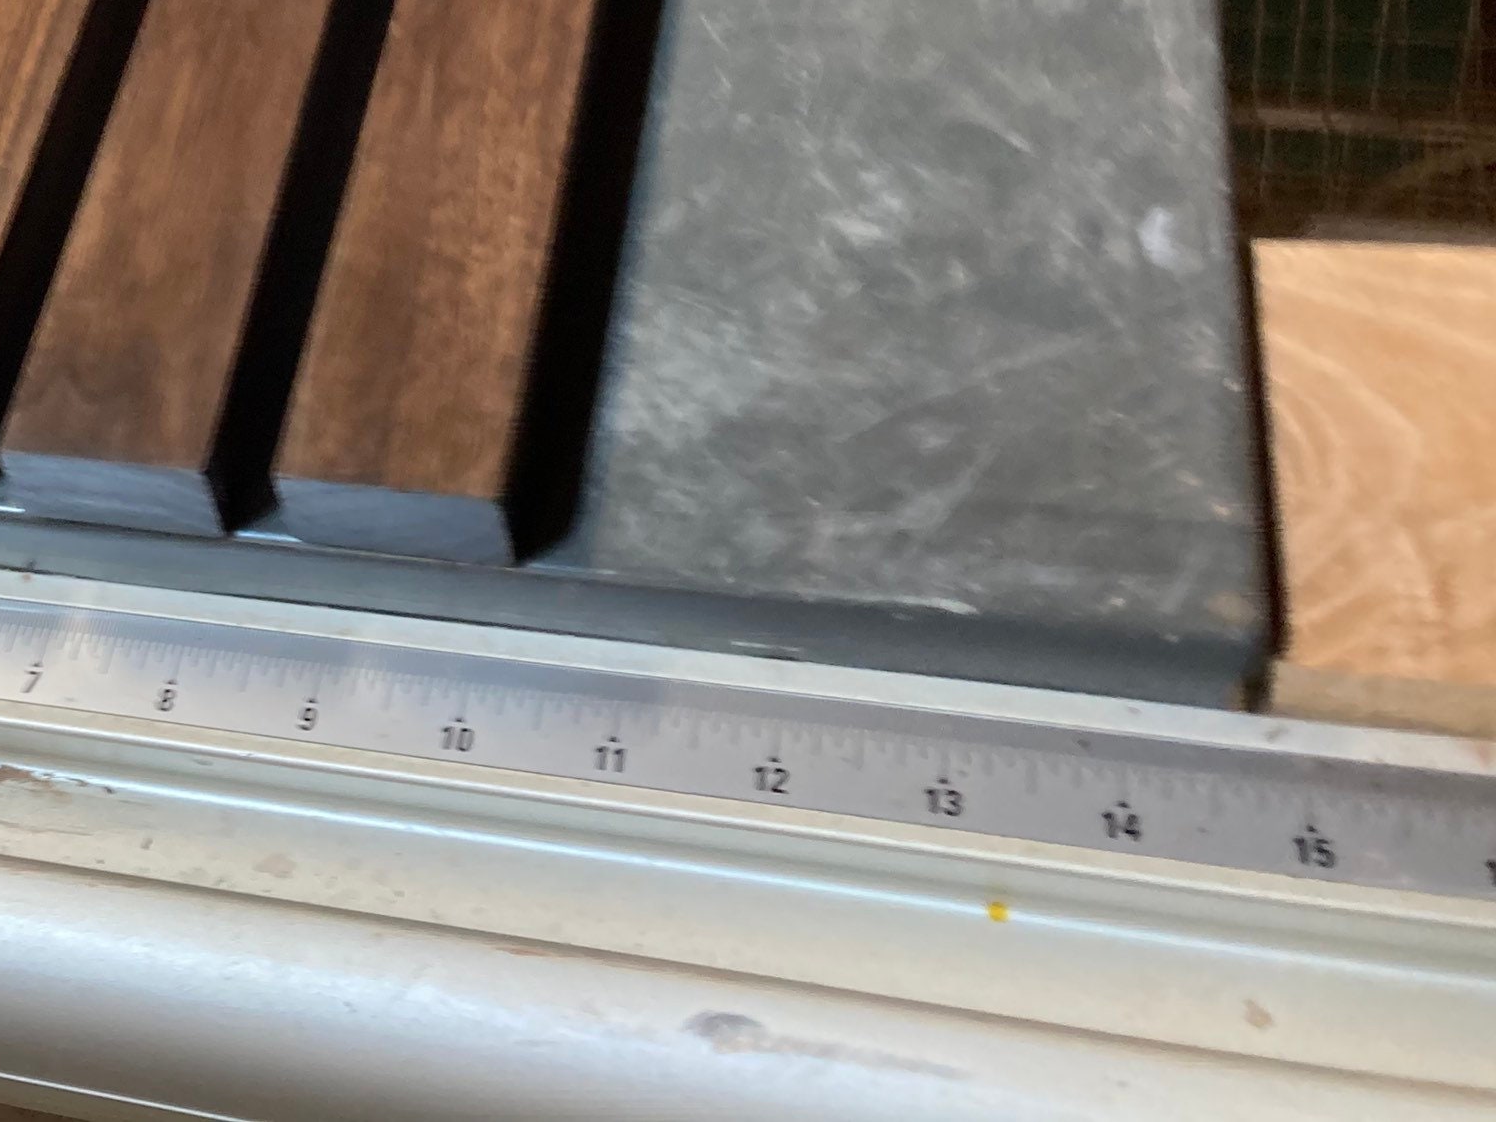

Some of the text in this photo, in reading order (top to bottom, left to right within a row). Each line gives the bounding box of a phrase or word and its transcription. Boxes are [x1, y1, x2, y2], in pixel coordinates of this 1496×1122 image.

[21, 668, 44, 693] 7
[155, 687, 177, 711] 8
[297, 707, 319, 731] 9
[439, 726, 475, 752] 10
[595, 745, 626, 773] 11
[753, 766, 791, 794] 12
[923, 788, 965, 817] 13
[1292, 837, 1336, 868] 15
